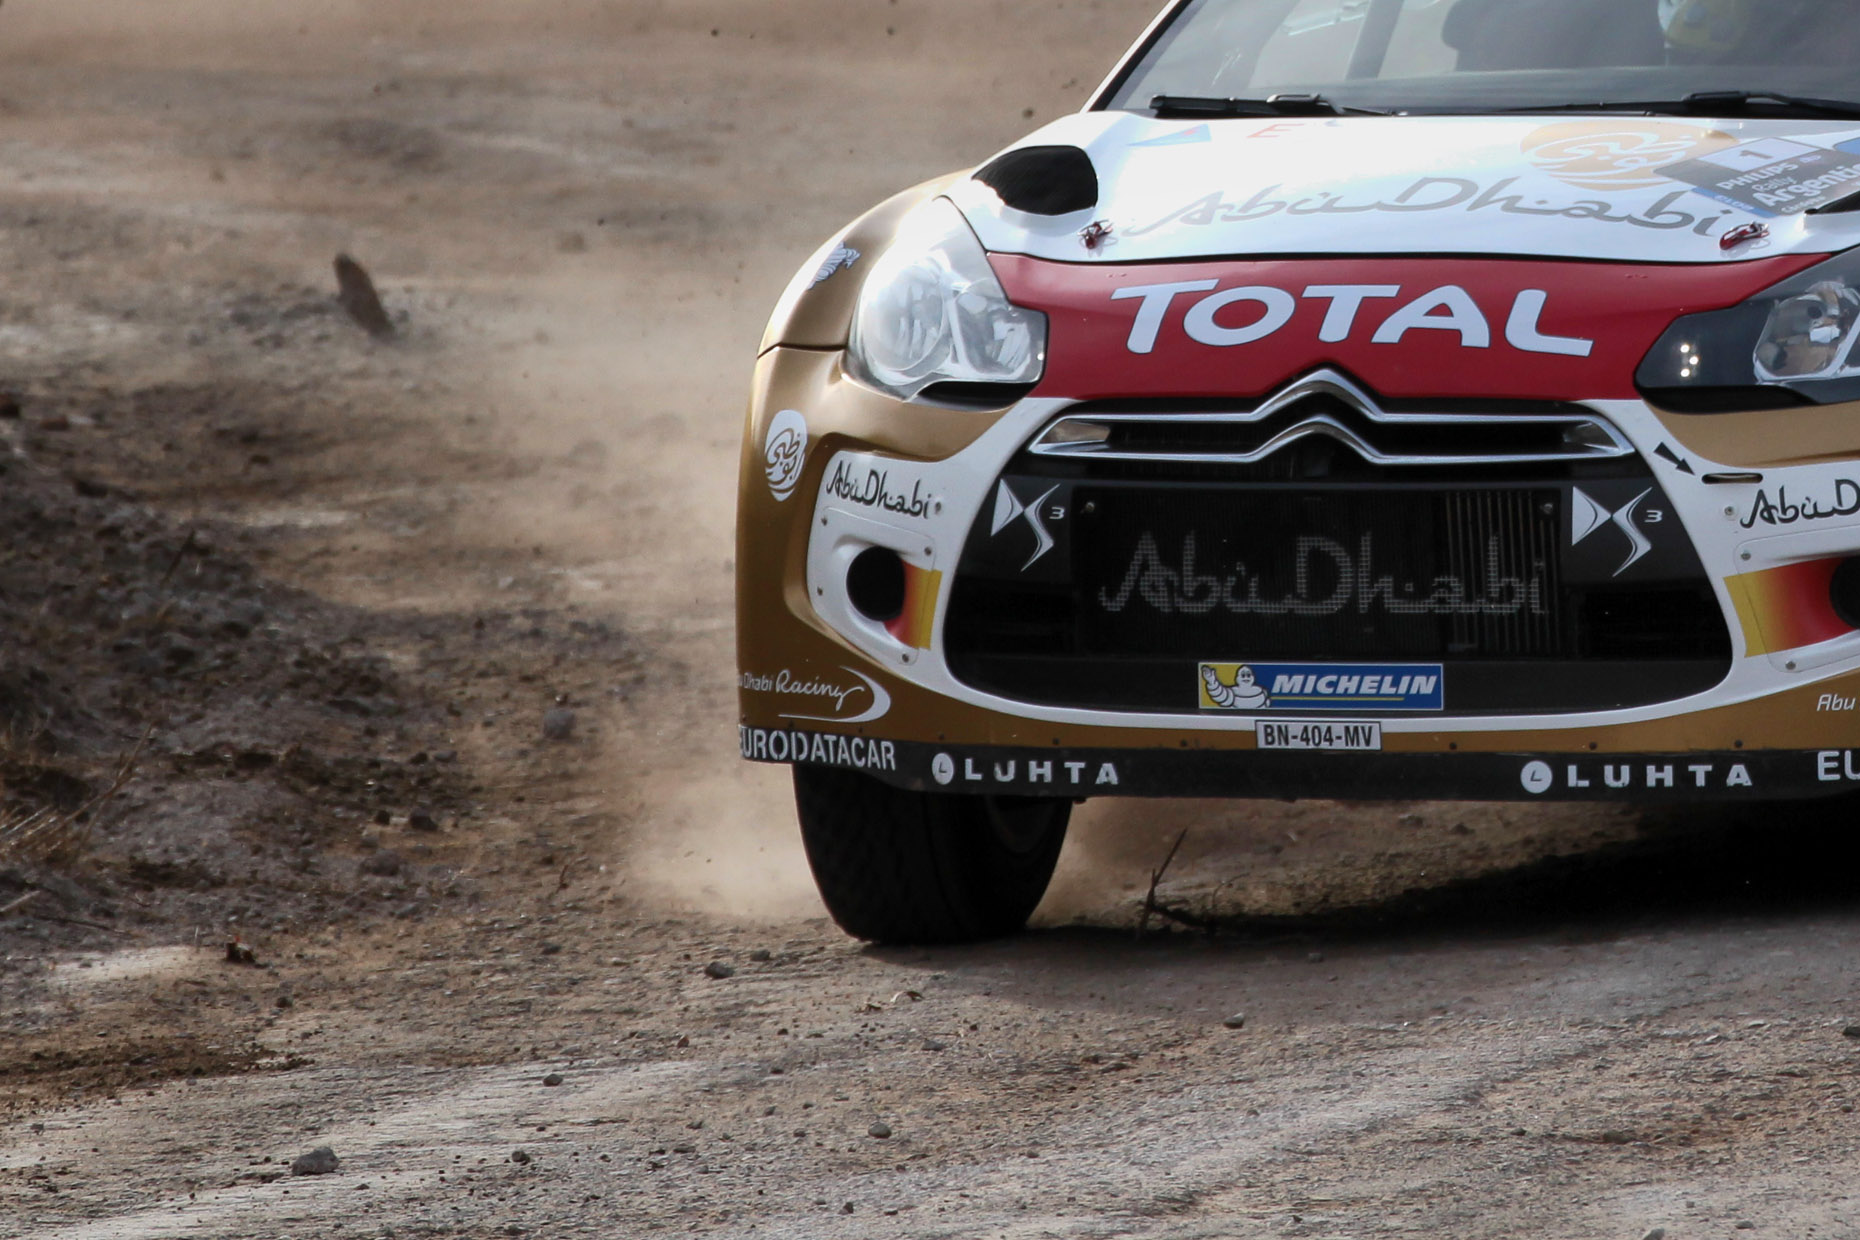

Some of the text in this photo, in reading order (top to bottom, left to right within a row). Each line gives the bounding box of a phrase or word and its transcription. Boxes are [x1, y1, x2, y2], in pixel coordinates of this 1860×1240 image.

[1716, 162, 1799, 191] PHILIPS
[1752, 176, 1798, 194] Rally
[1110, 278, 1595, 358] TOTAL
[775, 668, 865, 712] Racing
[1270, 672, 1440, 696] MICHELIN
[1817, 691, 1857, 712] Abu
[1262, 724, 1374, 748] BN-404-MV
[964, 757, 1120, 786] LUHTA
[1567, 763, 1754, 789] LUHTA
